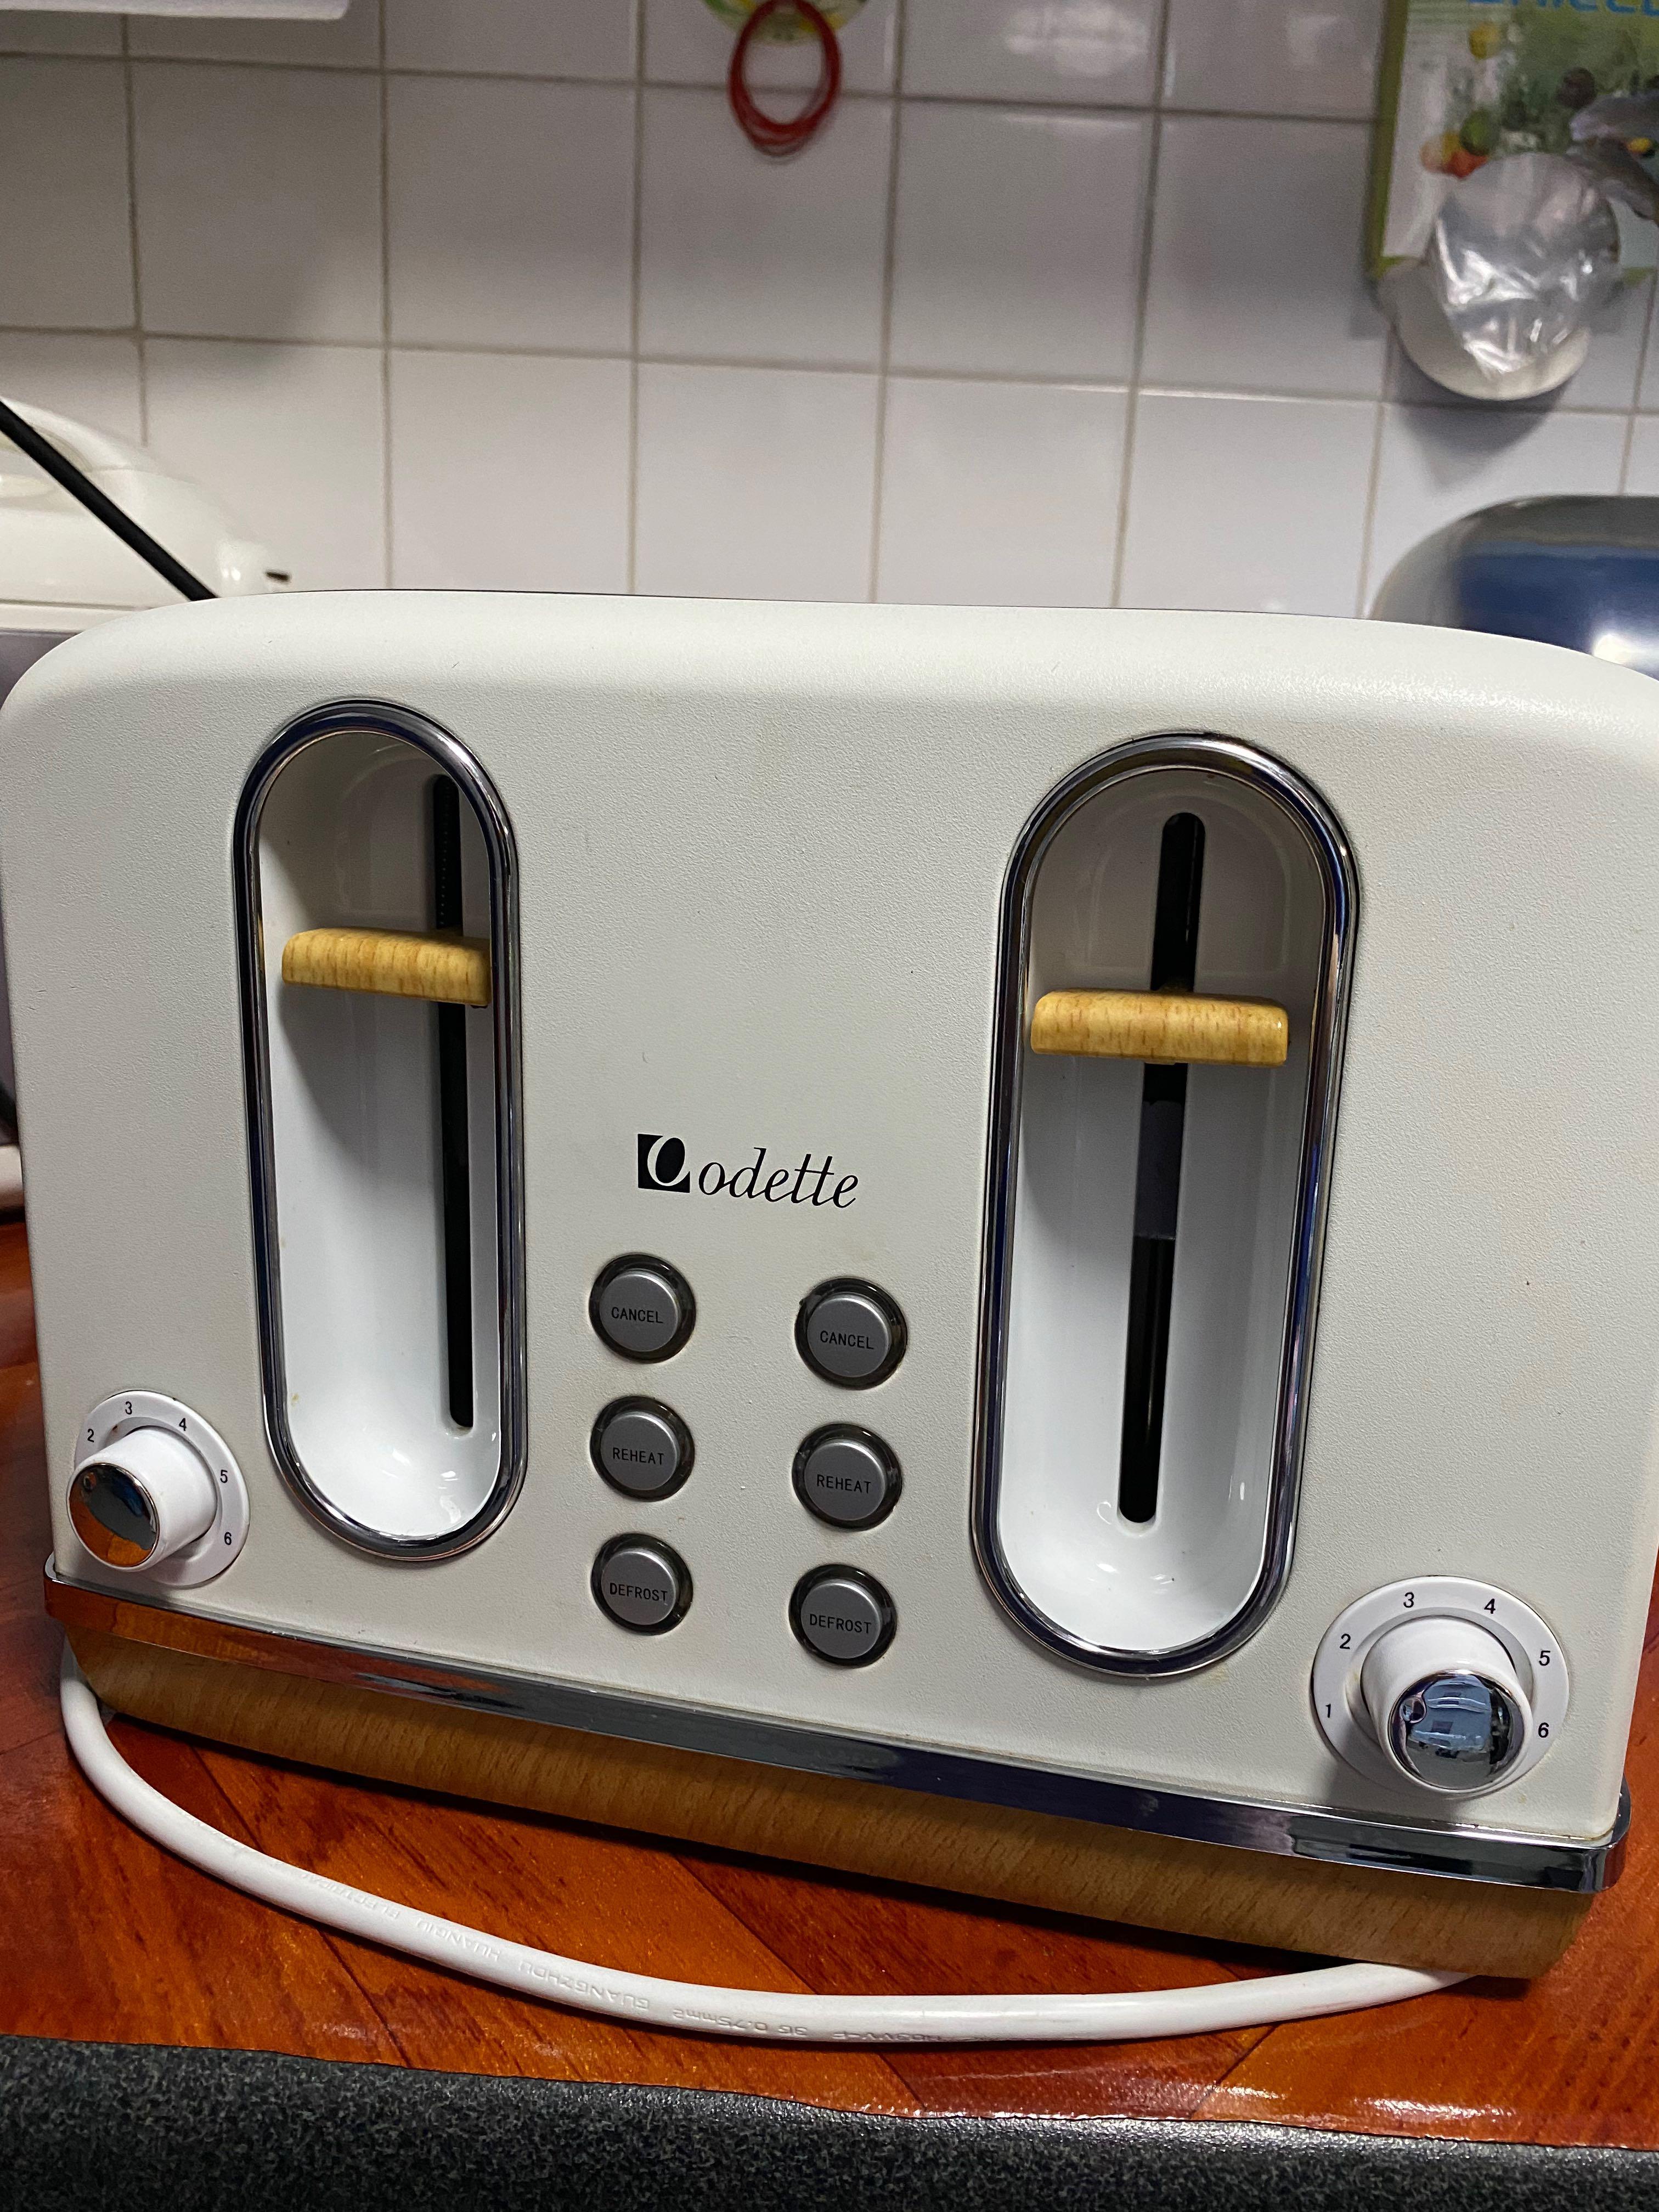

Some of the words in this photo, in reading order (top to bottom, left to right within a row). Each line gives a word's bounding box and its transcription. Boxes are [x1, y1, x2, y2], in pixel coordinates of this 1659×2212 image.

[611, 1306, 664, 1324] CANCEL
[819, 1329, 874, 1350] CANCEL
[124, 1400, 133, 1415] 3
[178, 1417, 188, 1432] 4
[86, 1427, 95, 1443] 2
[612, 1446, 665, 1466] REHEAT
[219, 1469, 229, 1484] 5
[816, 1473, 872, 1494] REHEAT
[223, 1531, 233, 1546] 6
[608, 1582, 668, 1602] DEFROST
[1402, 1591, 1415, 1609] 3
[1483, 1598, 1497, 1615] 4
[808, 1612, 872, 1634] DEFROST
[1339, 1633, 1352, 1650] 2
[1538, 1650, 1551, 1667] 5
[1325, 1703, 1332, 1719] 1
[1537, 1722, 1550, 1739] 6
